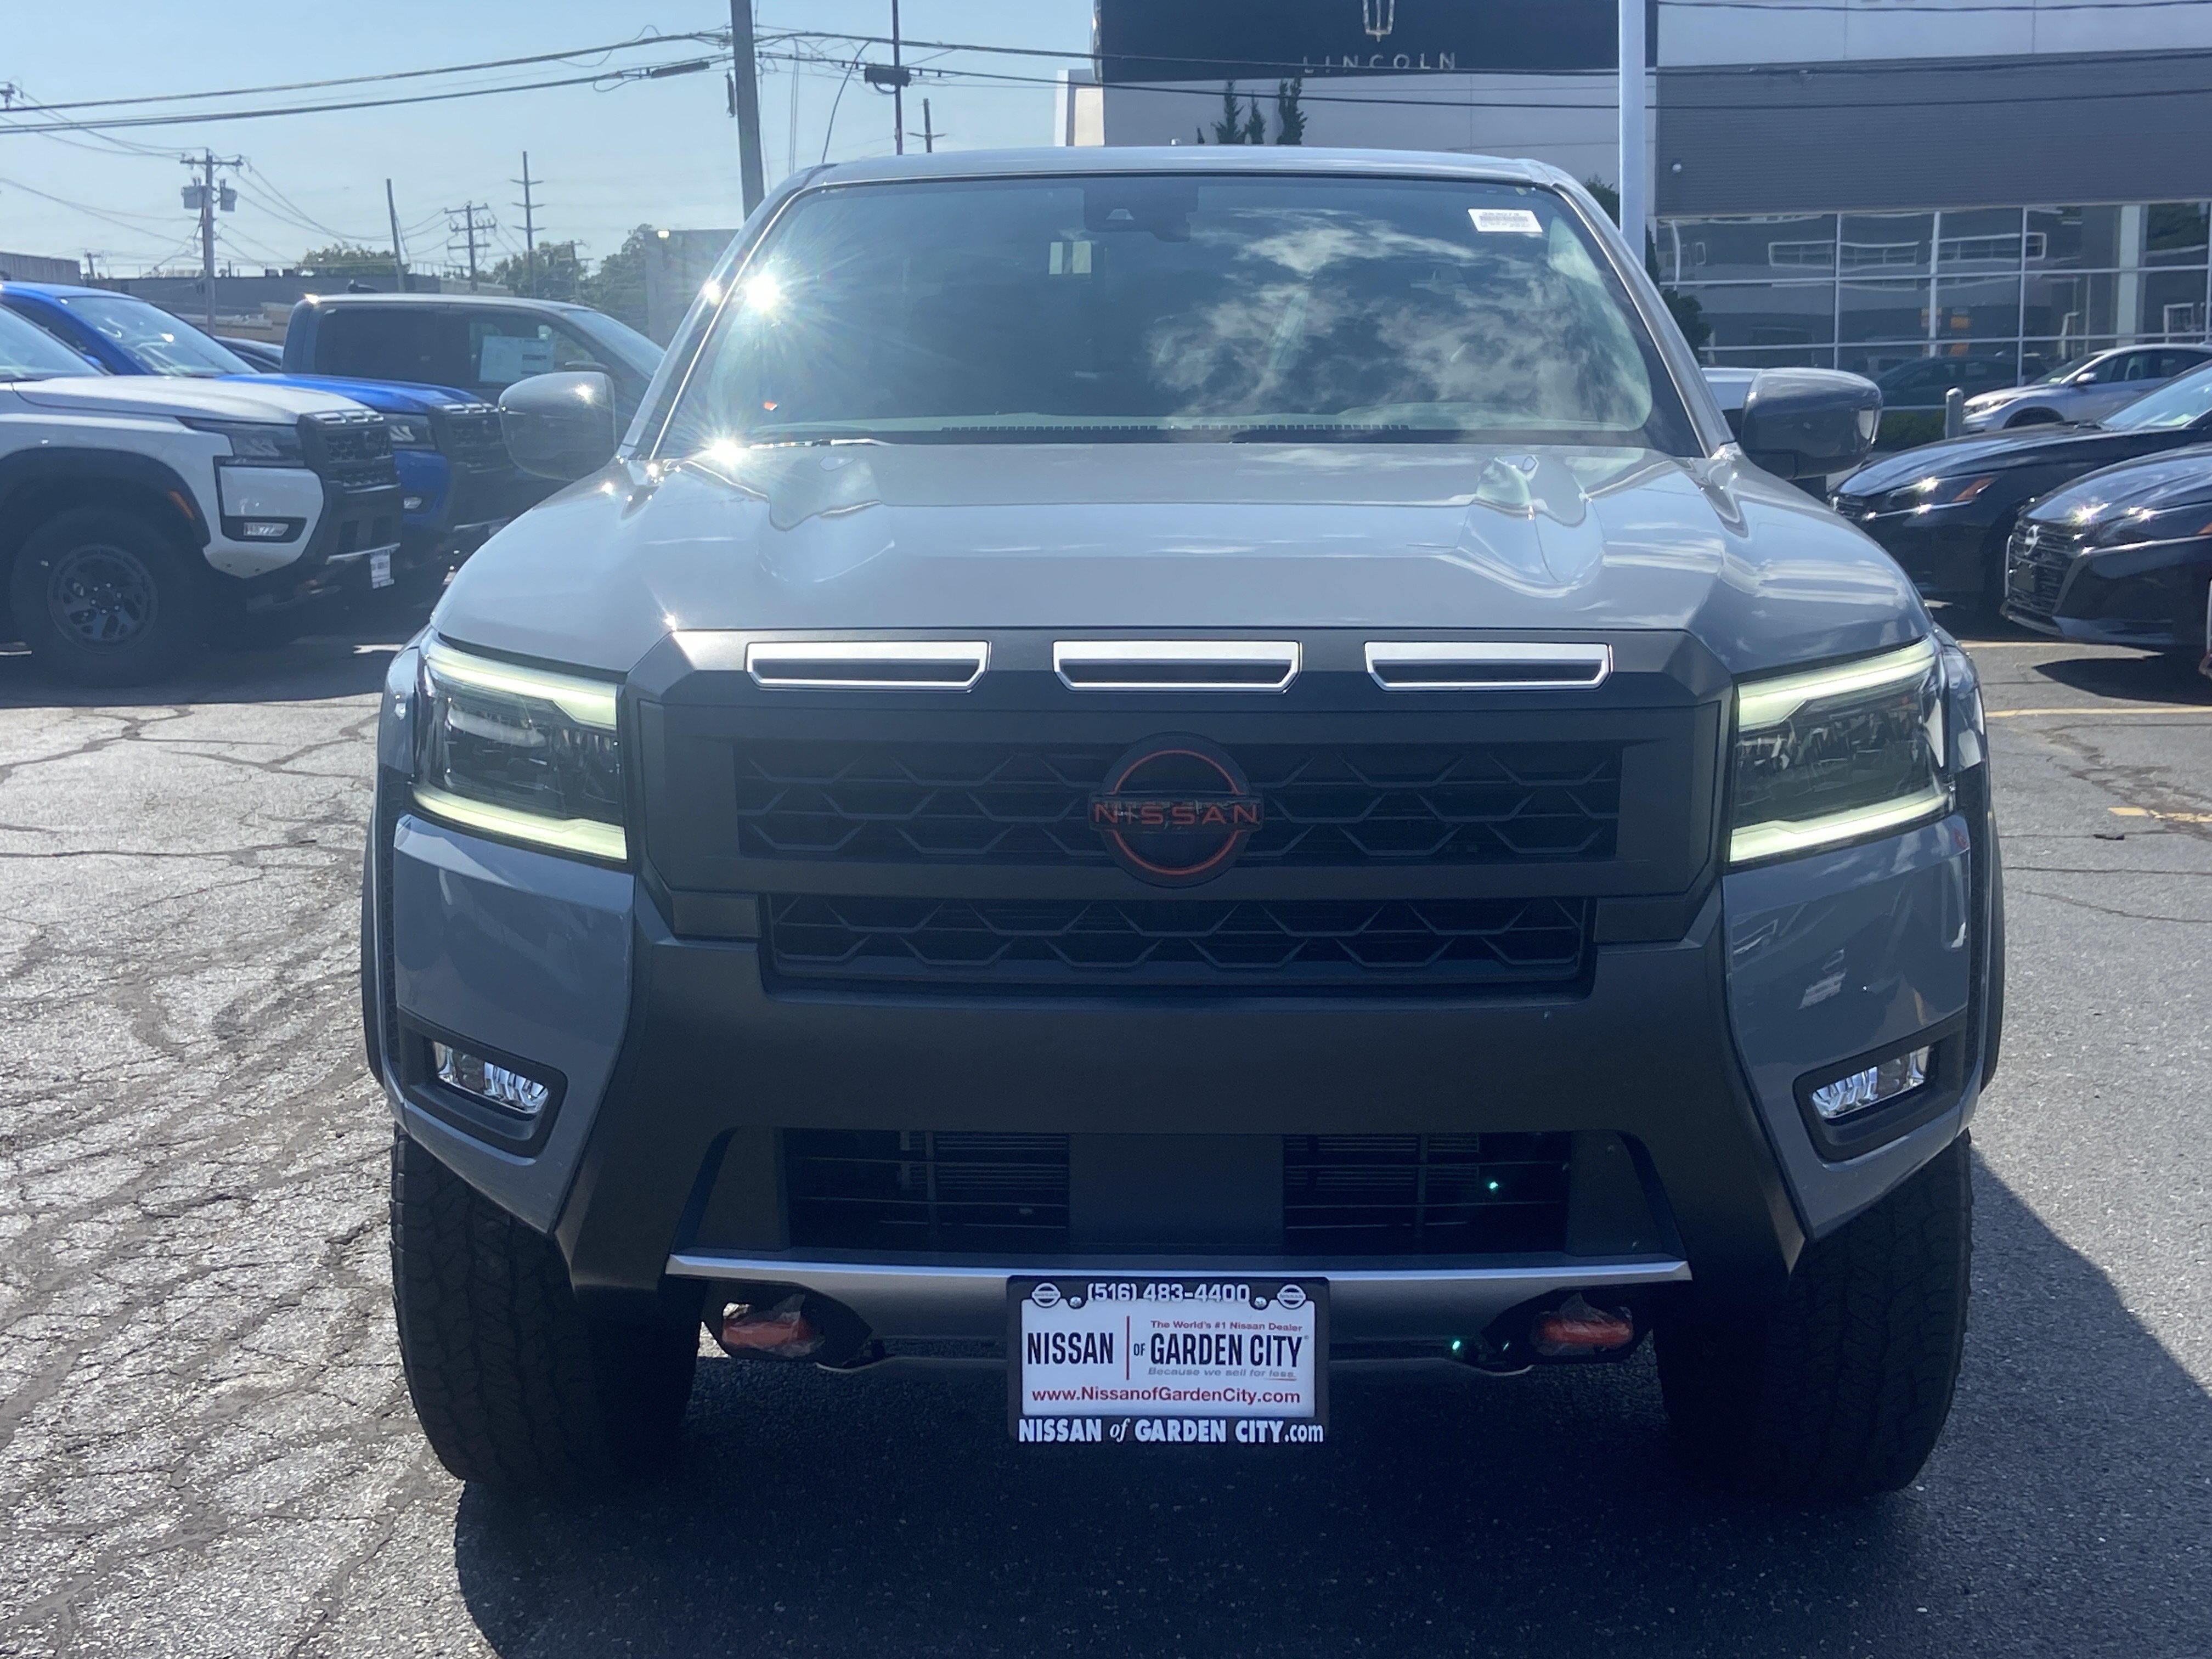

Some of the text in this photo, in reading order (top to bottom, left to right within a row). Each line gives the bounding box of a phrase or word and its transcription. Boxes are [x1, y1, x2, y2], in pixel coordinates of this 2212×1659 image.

[1302, 52, 1456, 74] LINCOLN
[1093, 803, 1259, 825] NISSAN
[1087, 1283, 1250, 1303] (516) 483-4400
[1150, 1320, 1170, 1329] The
[1173, 1321, 1211, 1329] World's
[1229, 1322, 1265, 1330] Nissan
[1268, 1323, 1303, 1332] Dealer
[1028, 1332, 1302, 1367] NISSAN OF GARDEN CITY
[1249, 1369, 1266, 1378] for
[1032, 1386, 1300, 1405] www.NissanofGardenCity.com
[1019, 1418, 1324, 1443] NISSAN of GARDEN CITY.com
